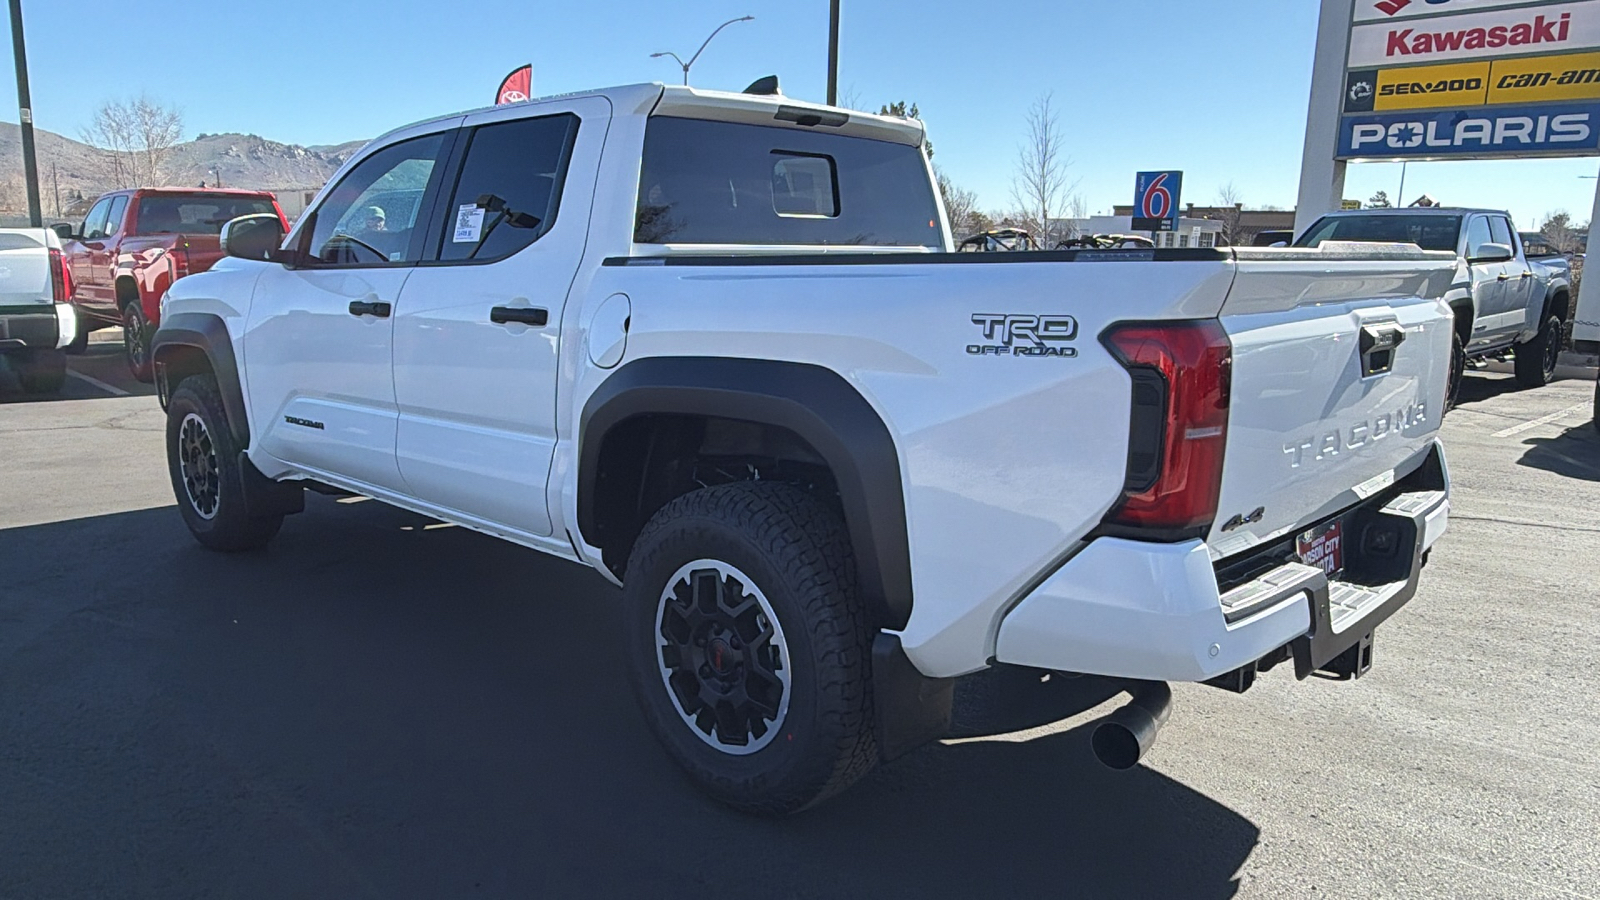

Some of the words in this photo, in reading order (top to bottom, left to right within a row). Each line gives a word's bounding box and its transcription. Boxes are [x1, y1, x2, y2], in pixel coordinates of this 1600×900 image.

[1386, 12, 1571, 57] Kawasaki
[1496, 68, 1600, 89] can-am
[1351, 113, 1590, 149] POLARIS
[1142, 173, 1171, 218] 6
[971, 313, 1079, 346] TRD
[966, 345, 1011, 356] OFF
[1013, 346, 1078, 358] ROAD
[1282, 402, 1428, 469] TACOMA
[1324, 535, 1340, 554] CITY
